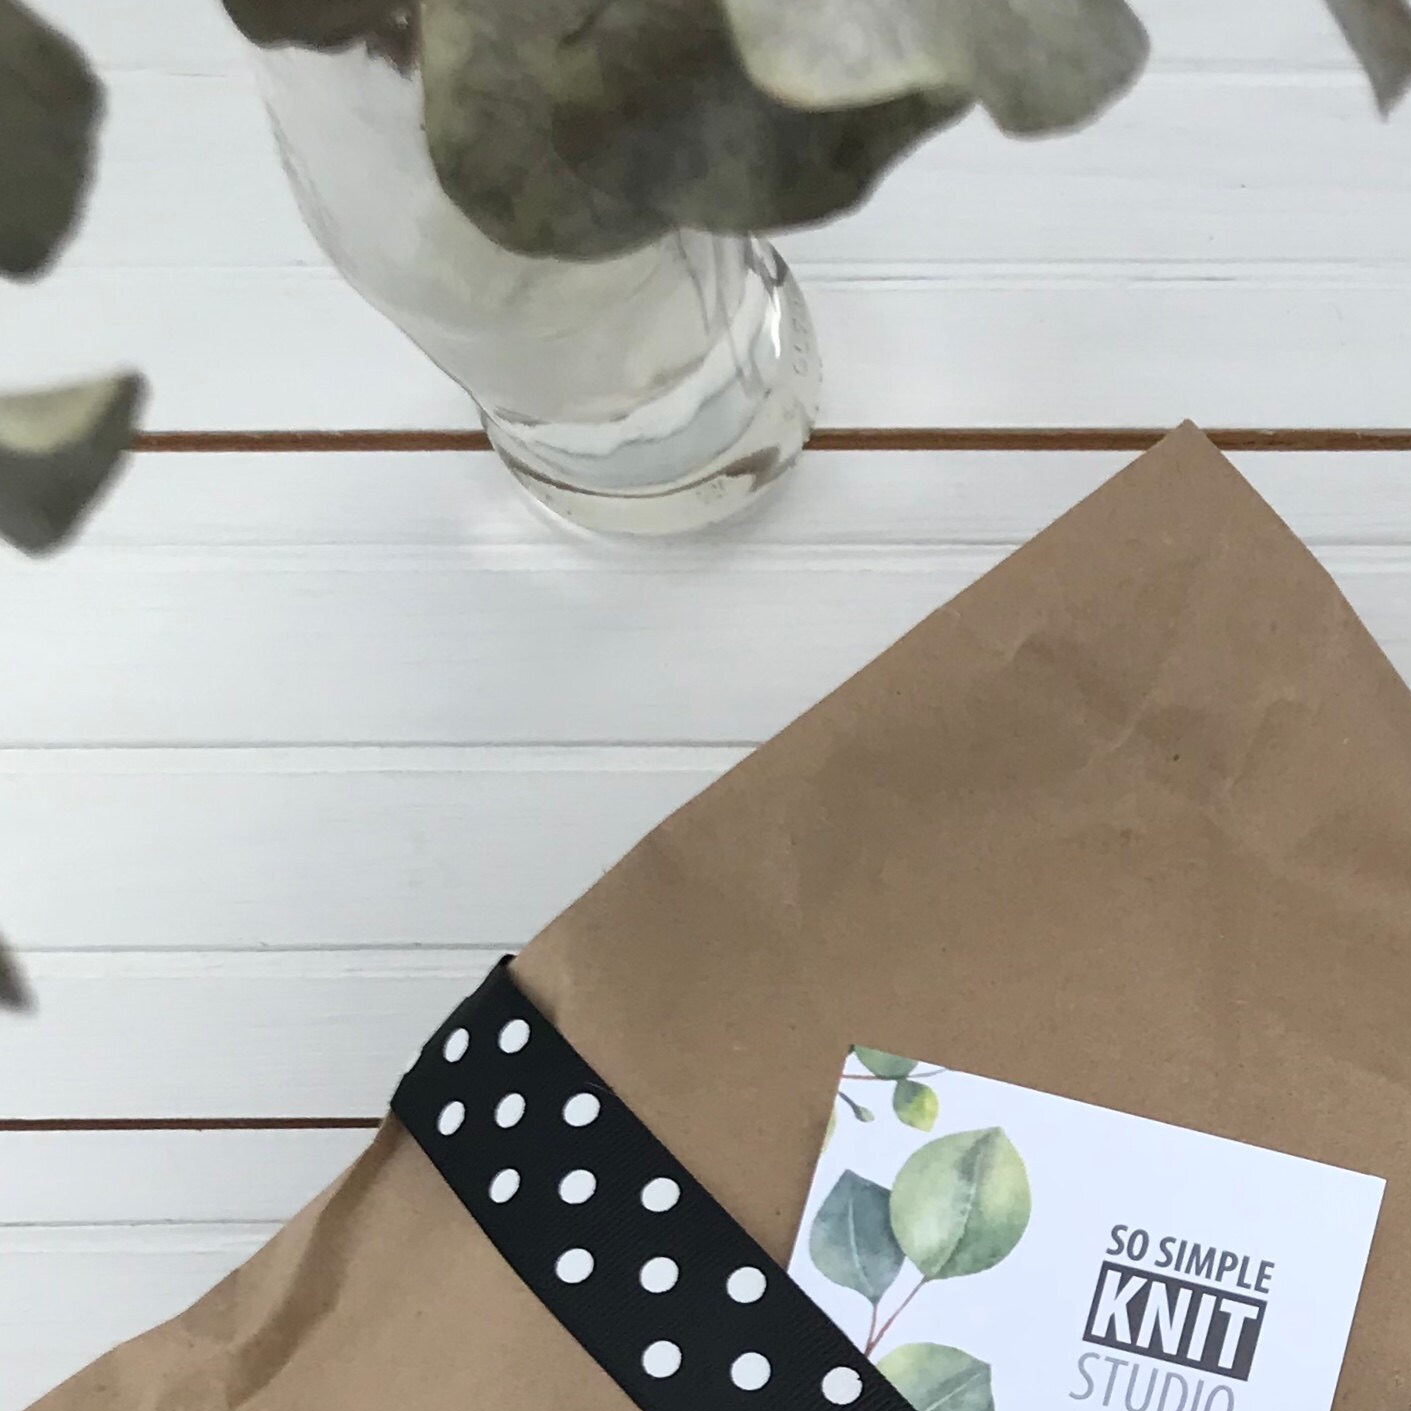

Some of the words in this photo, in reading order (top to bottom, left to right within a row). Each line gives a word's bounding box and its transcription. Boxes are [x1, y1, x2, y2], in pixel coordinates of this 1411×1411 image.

[1106, 1224, 1150, 1262] SO
[1154, 1236, 1275, 1294] SIMPLE
[1090, 1269, 1260, 1370] KNIT
